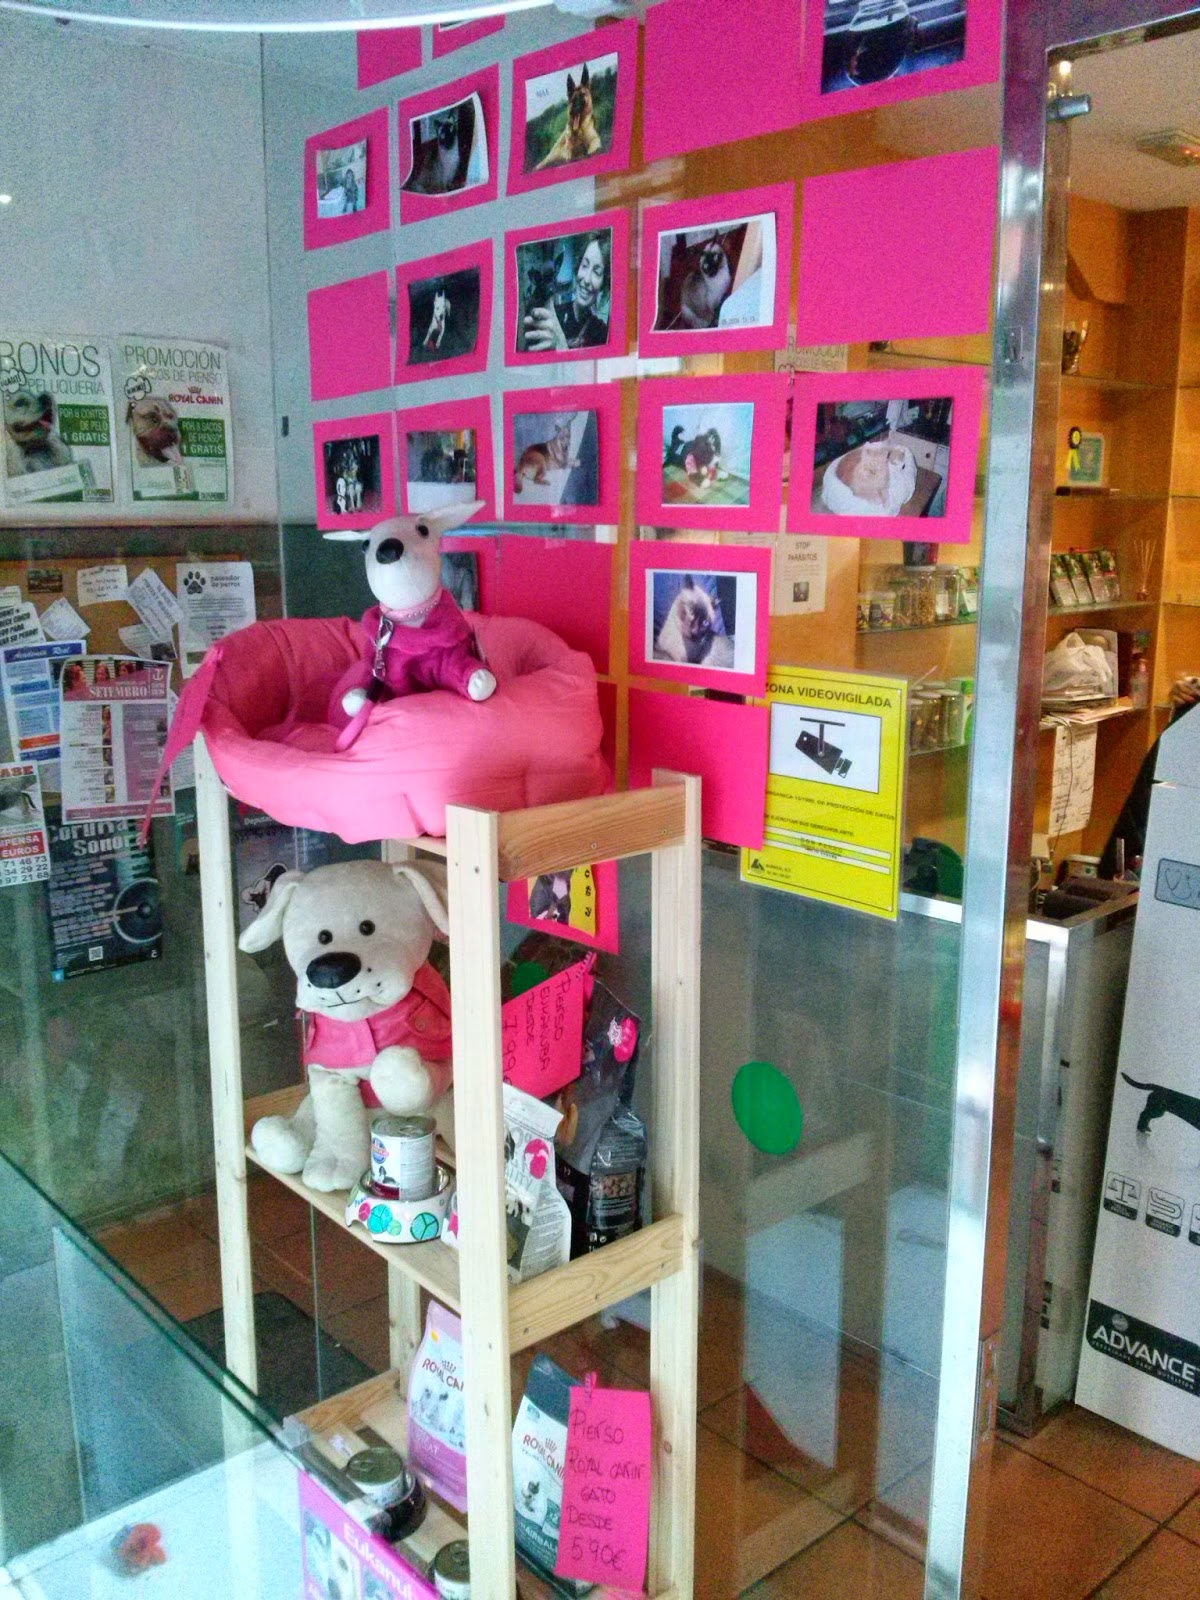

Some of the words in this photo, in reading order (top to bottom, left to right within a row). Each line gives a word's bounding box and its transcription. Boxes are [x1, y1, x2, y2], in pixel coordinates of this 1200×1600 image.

[0, 341, 100, 378] BONOS
[124, 345, 221, 370] PROMOCIÓN
[169, 393, 195, 404] ROYAL
[196, 395, 224, 405] CANIN
[72, 432, 107, 443] GRATIS
[190, 444, 223, 455] GRATIS
[797, 686, 892, 709] VIDEOVIGILADA
[2, 845, 40, 858] EUROS
[36, 863, 48, 871] 22
[1093, 1325, 1197, 1383] ADVANCE
[422, 1357, 445, 1383] ROYAL
[570, 1408, 625, 1445] PIENSO
[567, 1446, 603, 1478] ROYAL
[580, 1486, 616, 1504] GATO
[566, 1504, 613, 1531] DESDE
